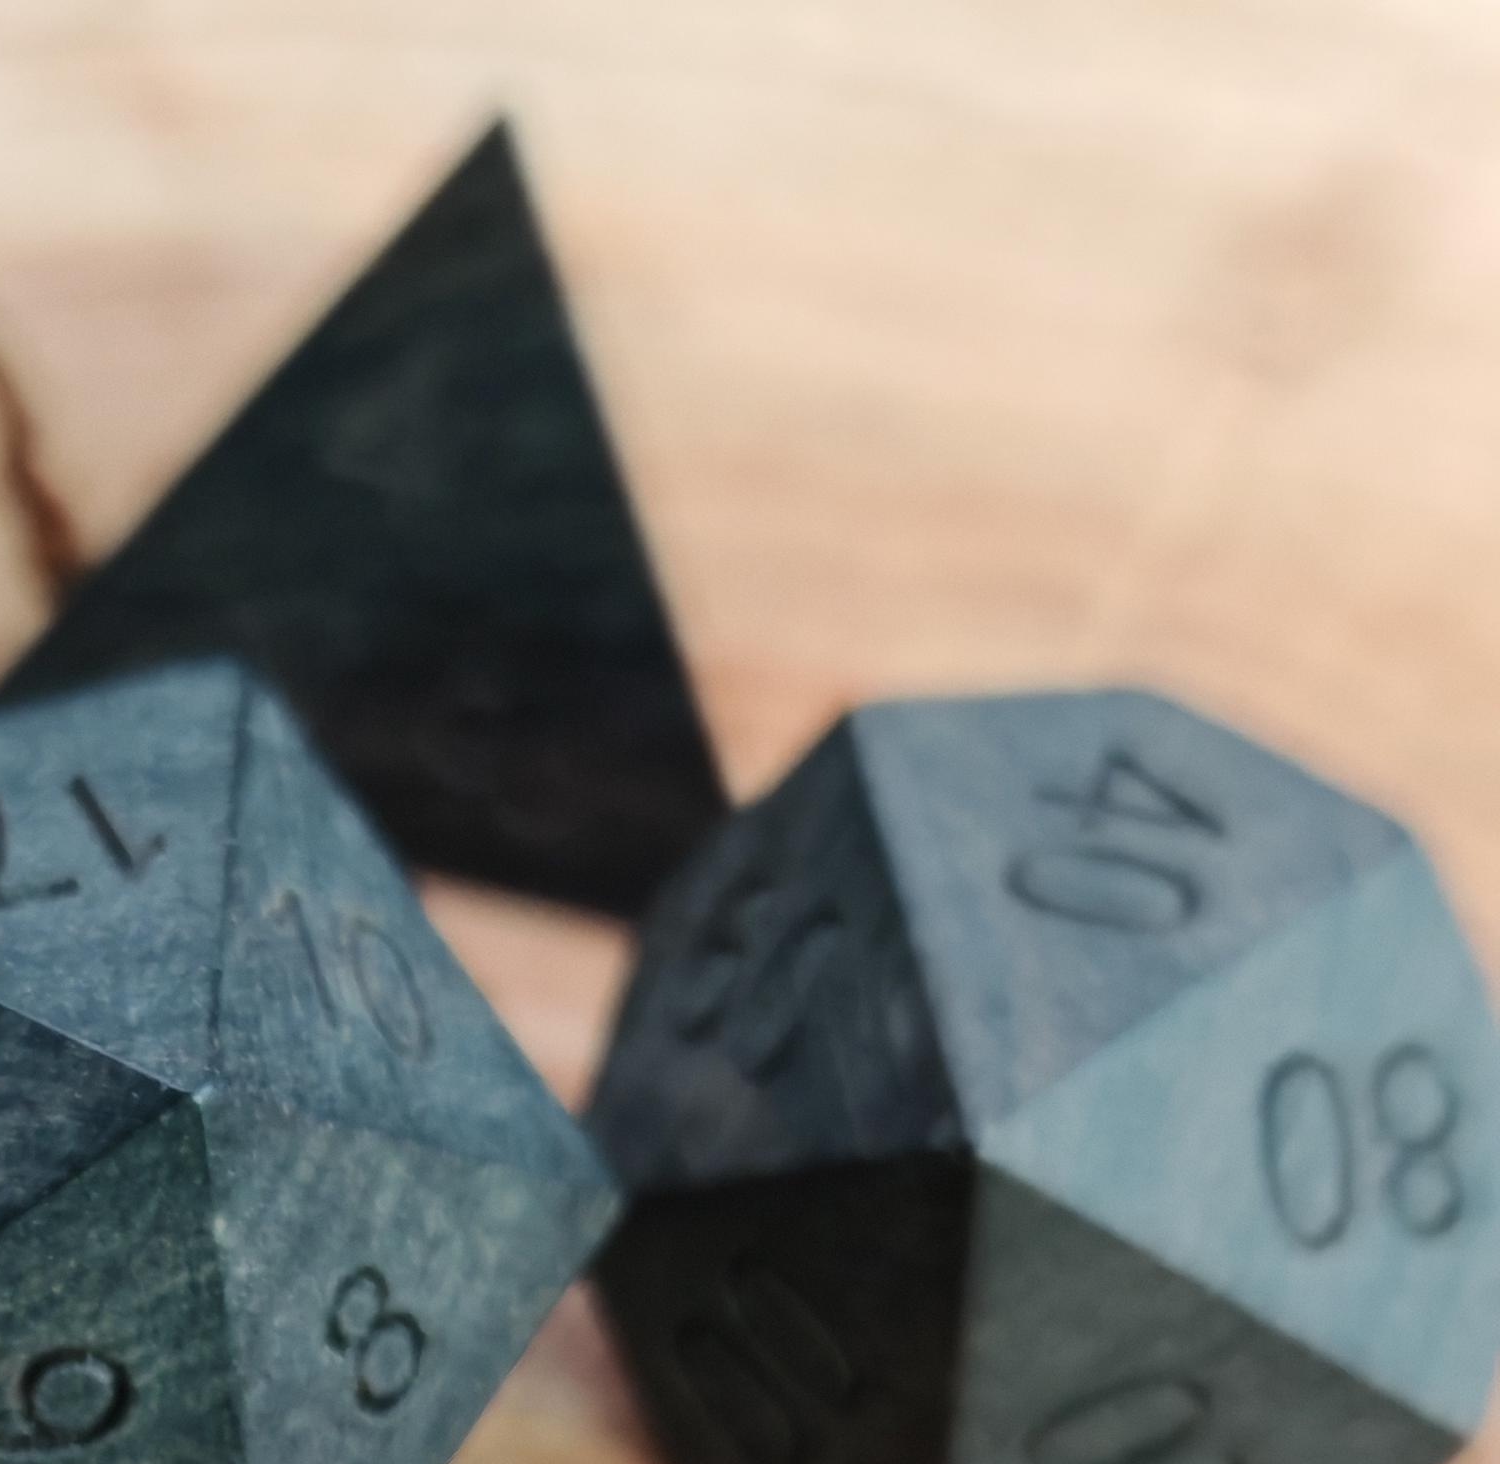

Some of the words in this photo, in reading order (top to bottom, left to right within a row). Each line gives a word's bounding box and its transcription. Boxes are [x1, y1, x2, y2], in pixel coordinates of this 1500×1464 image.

[1003, 748, 1228, 935] 40
[244, 887, 435, 1064] 10
[1257, 1041, 1465, 1252] 80
[326, 1264, 429, 1418] 8
